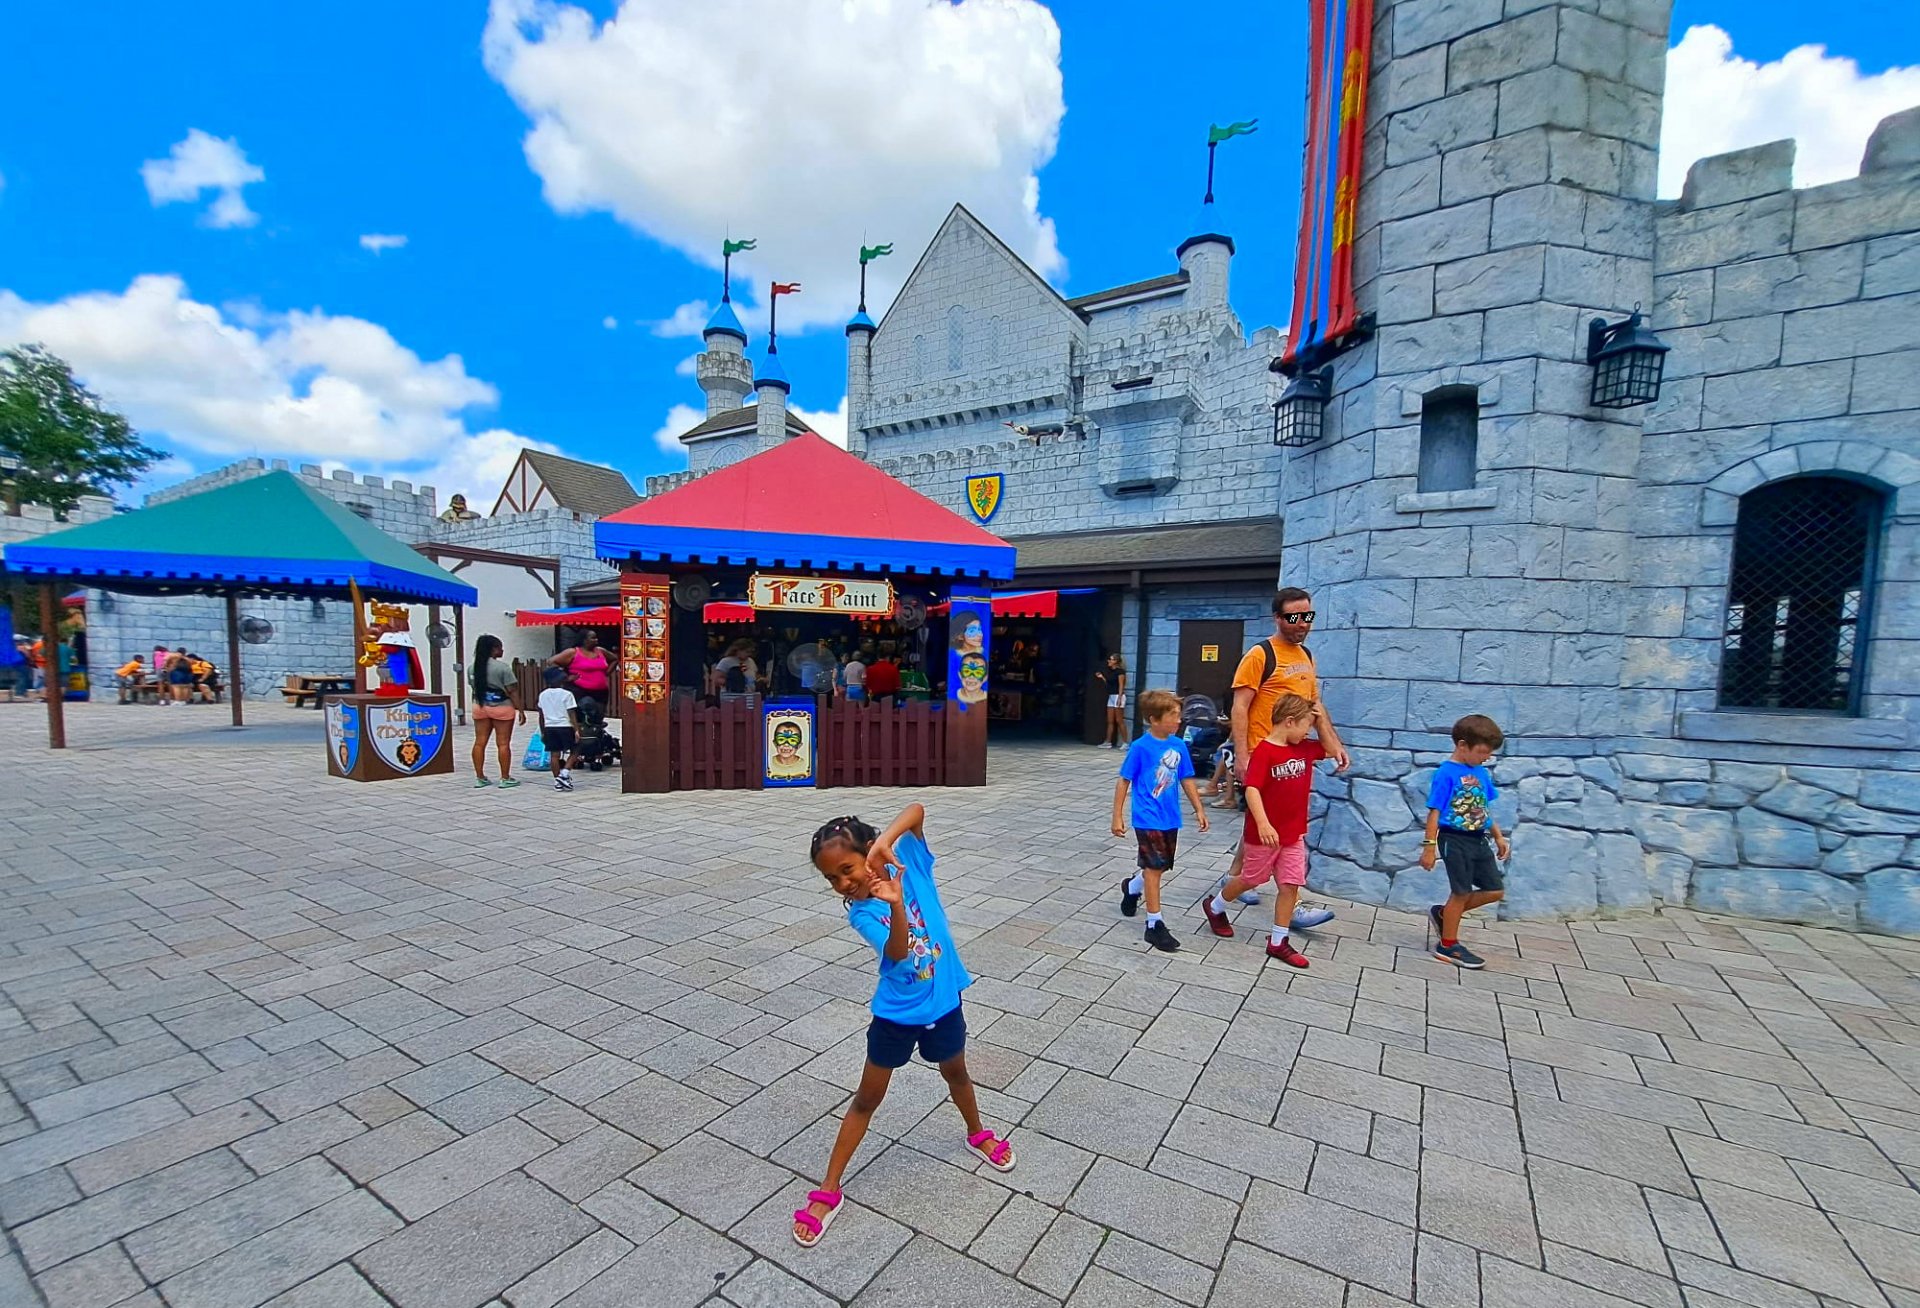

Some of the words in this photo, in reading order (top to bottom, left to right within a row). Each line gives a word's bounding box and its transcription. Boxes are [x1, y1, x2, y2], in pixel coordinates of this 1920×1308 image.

[764, 580, 816, 606] Face
[815, 582, 878, 608] Paint
[384, 708, 431, 723] Kings
[376, 724, 438, 739] Market
